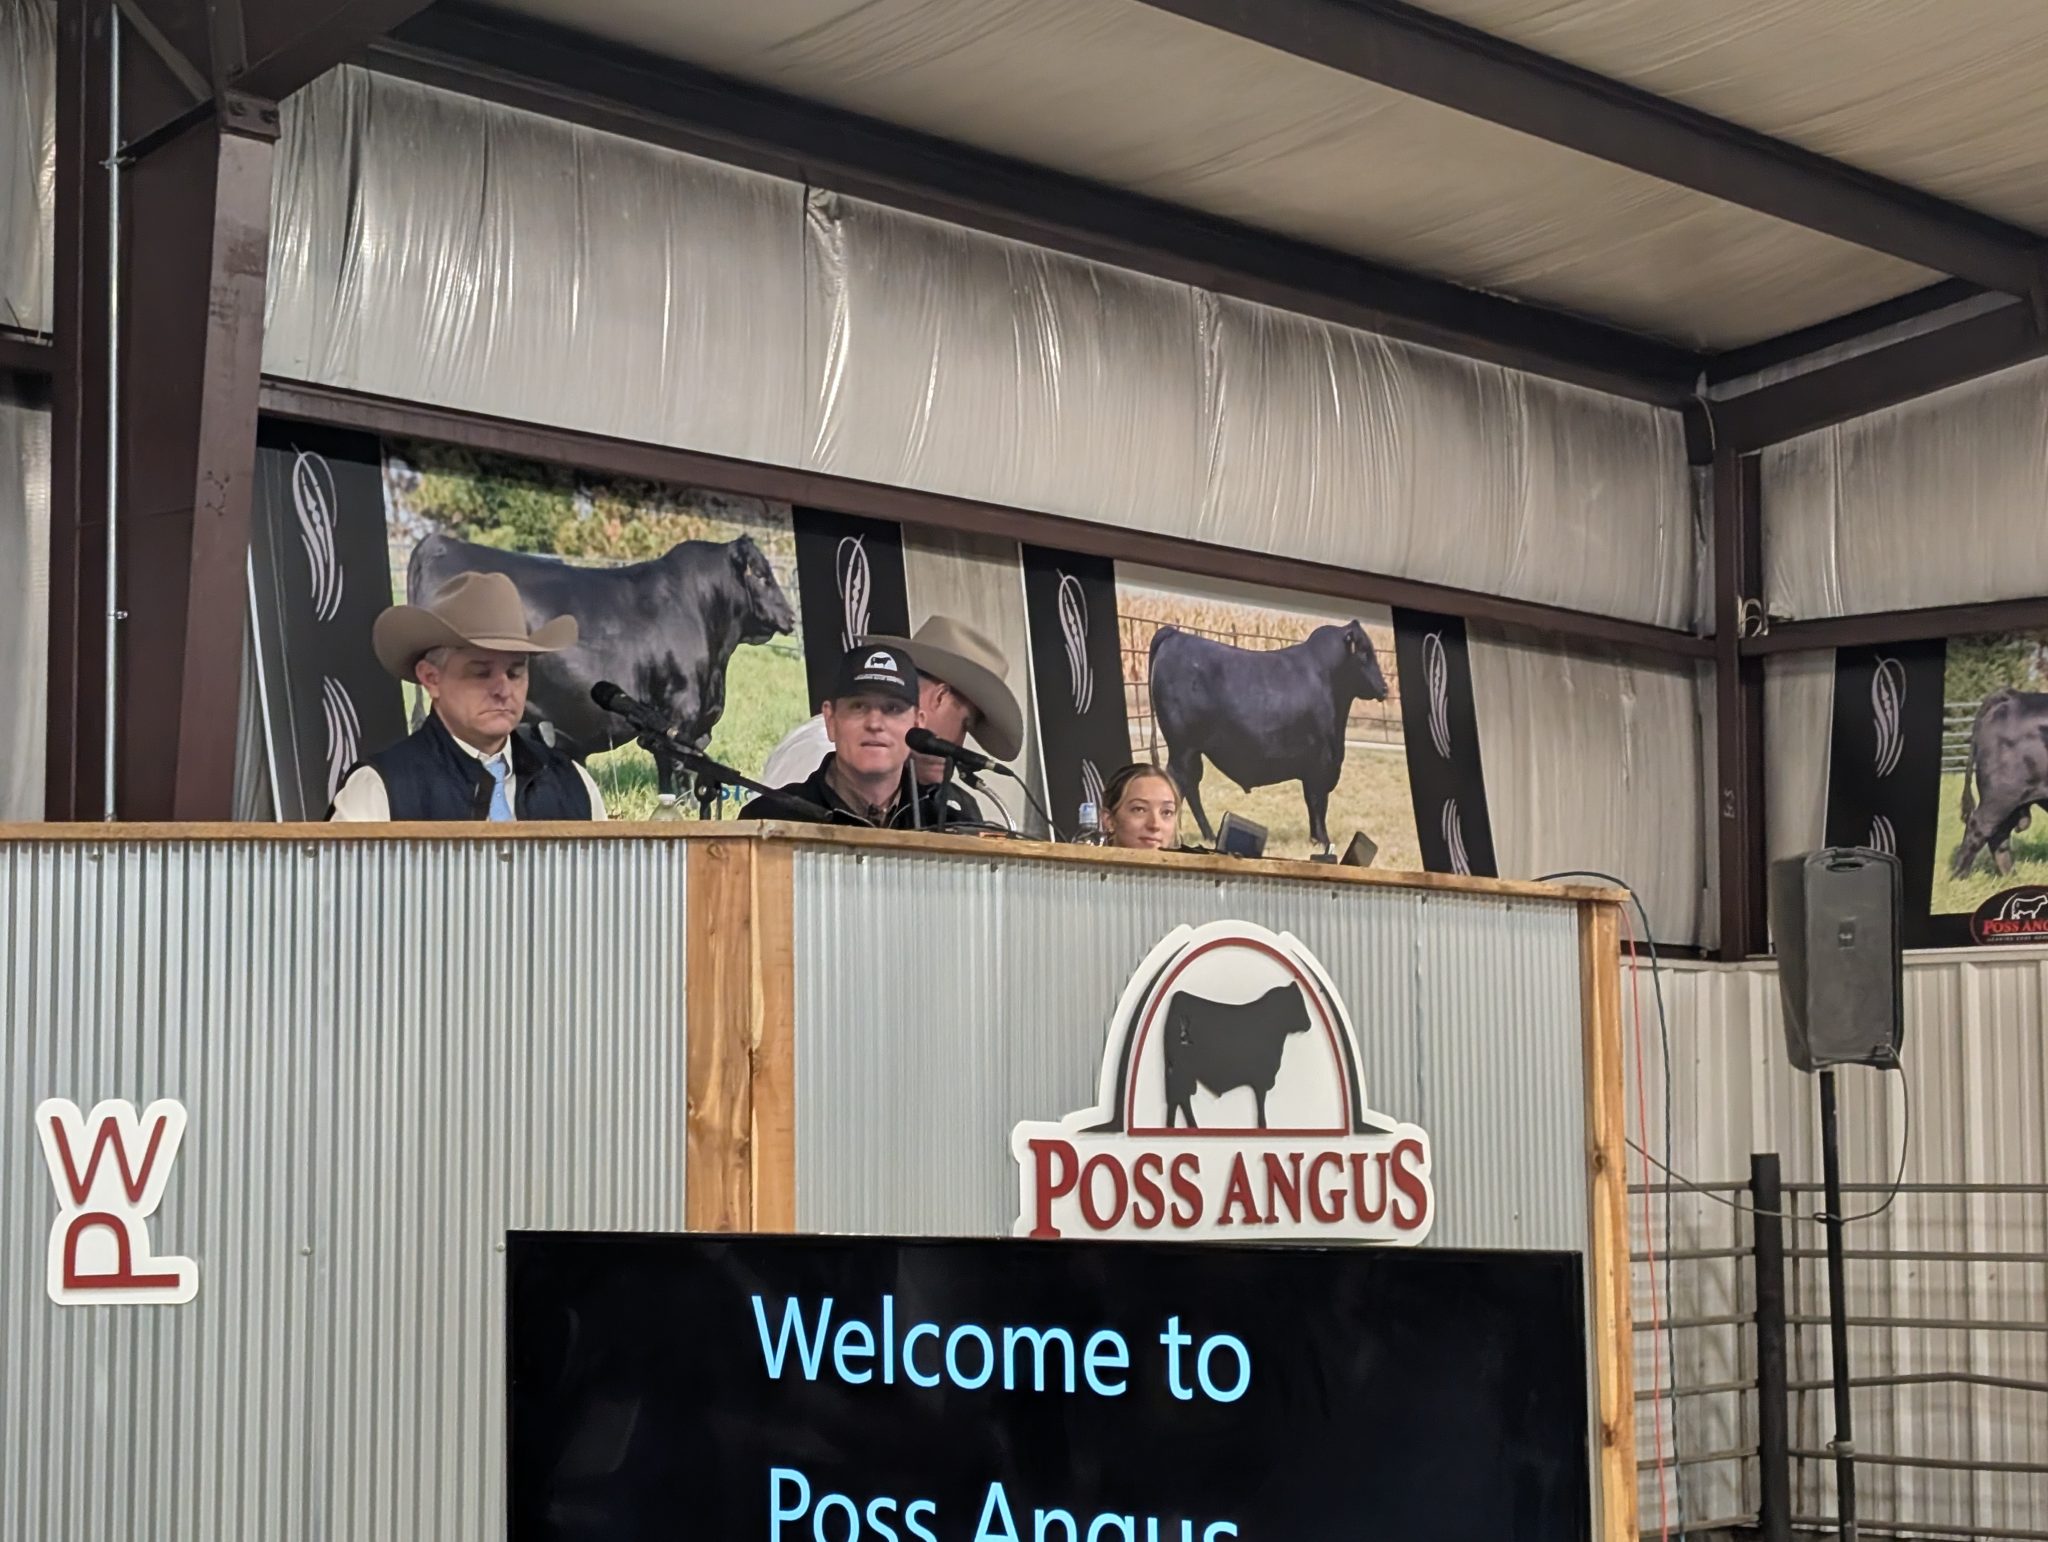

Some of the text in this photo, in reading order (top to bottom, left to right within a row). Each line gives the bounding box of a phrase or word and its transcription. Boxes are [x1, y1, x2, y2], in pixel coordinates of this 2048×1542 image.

[1982, 919, 2020, 935] POSS
[1028, 1138, 1428, 1239] POSS ANGUS
[751, 1294, 1252, 1403] Welcome to
[769, 1467, 939, 1542] Poss
